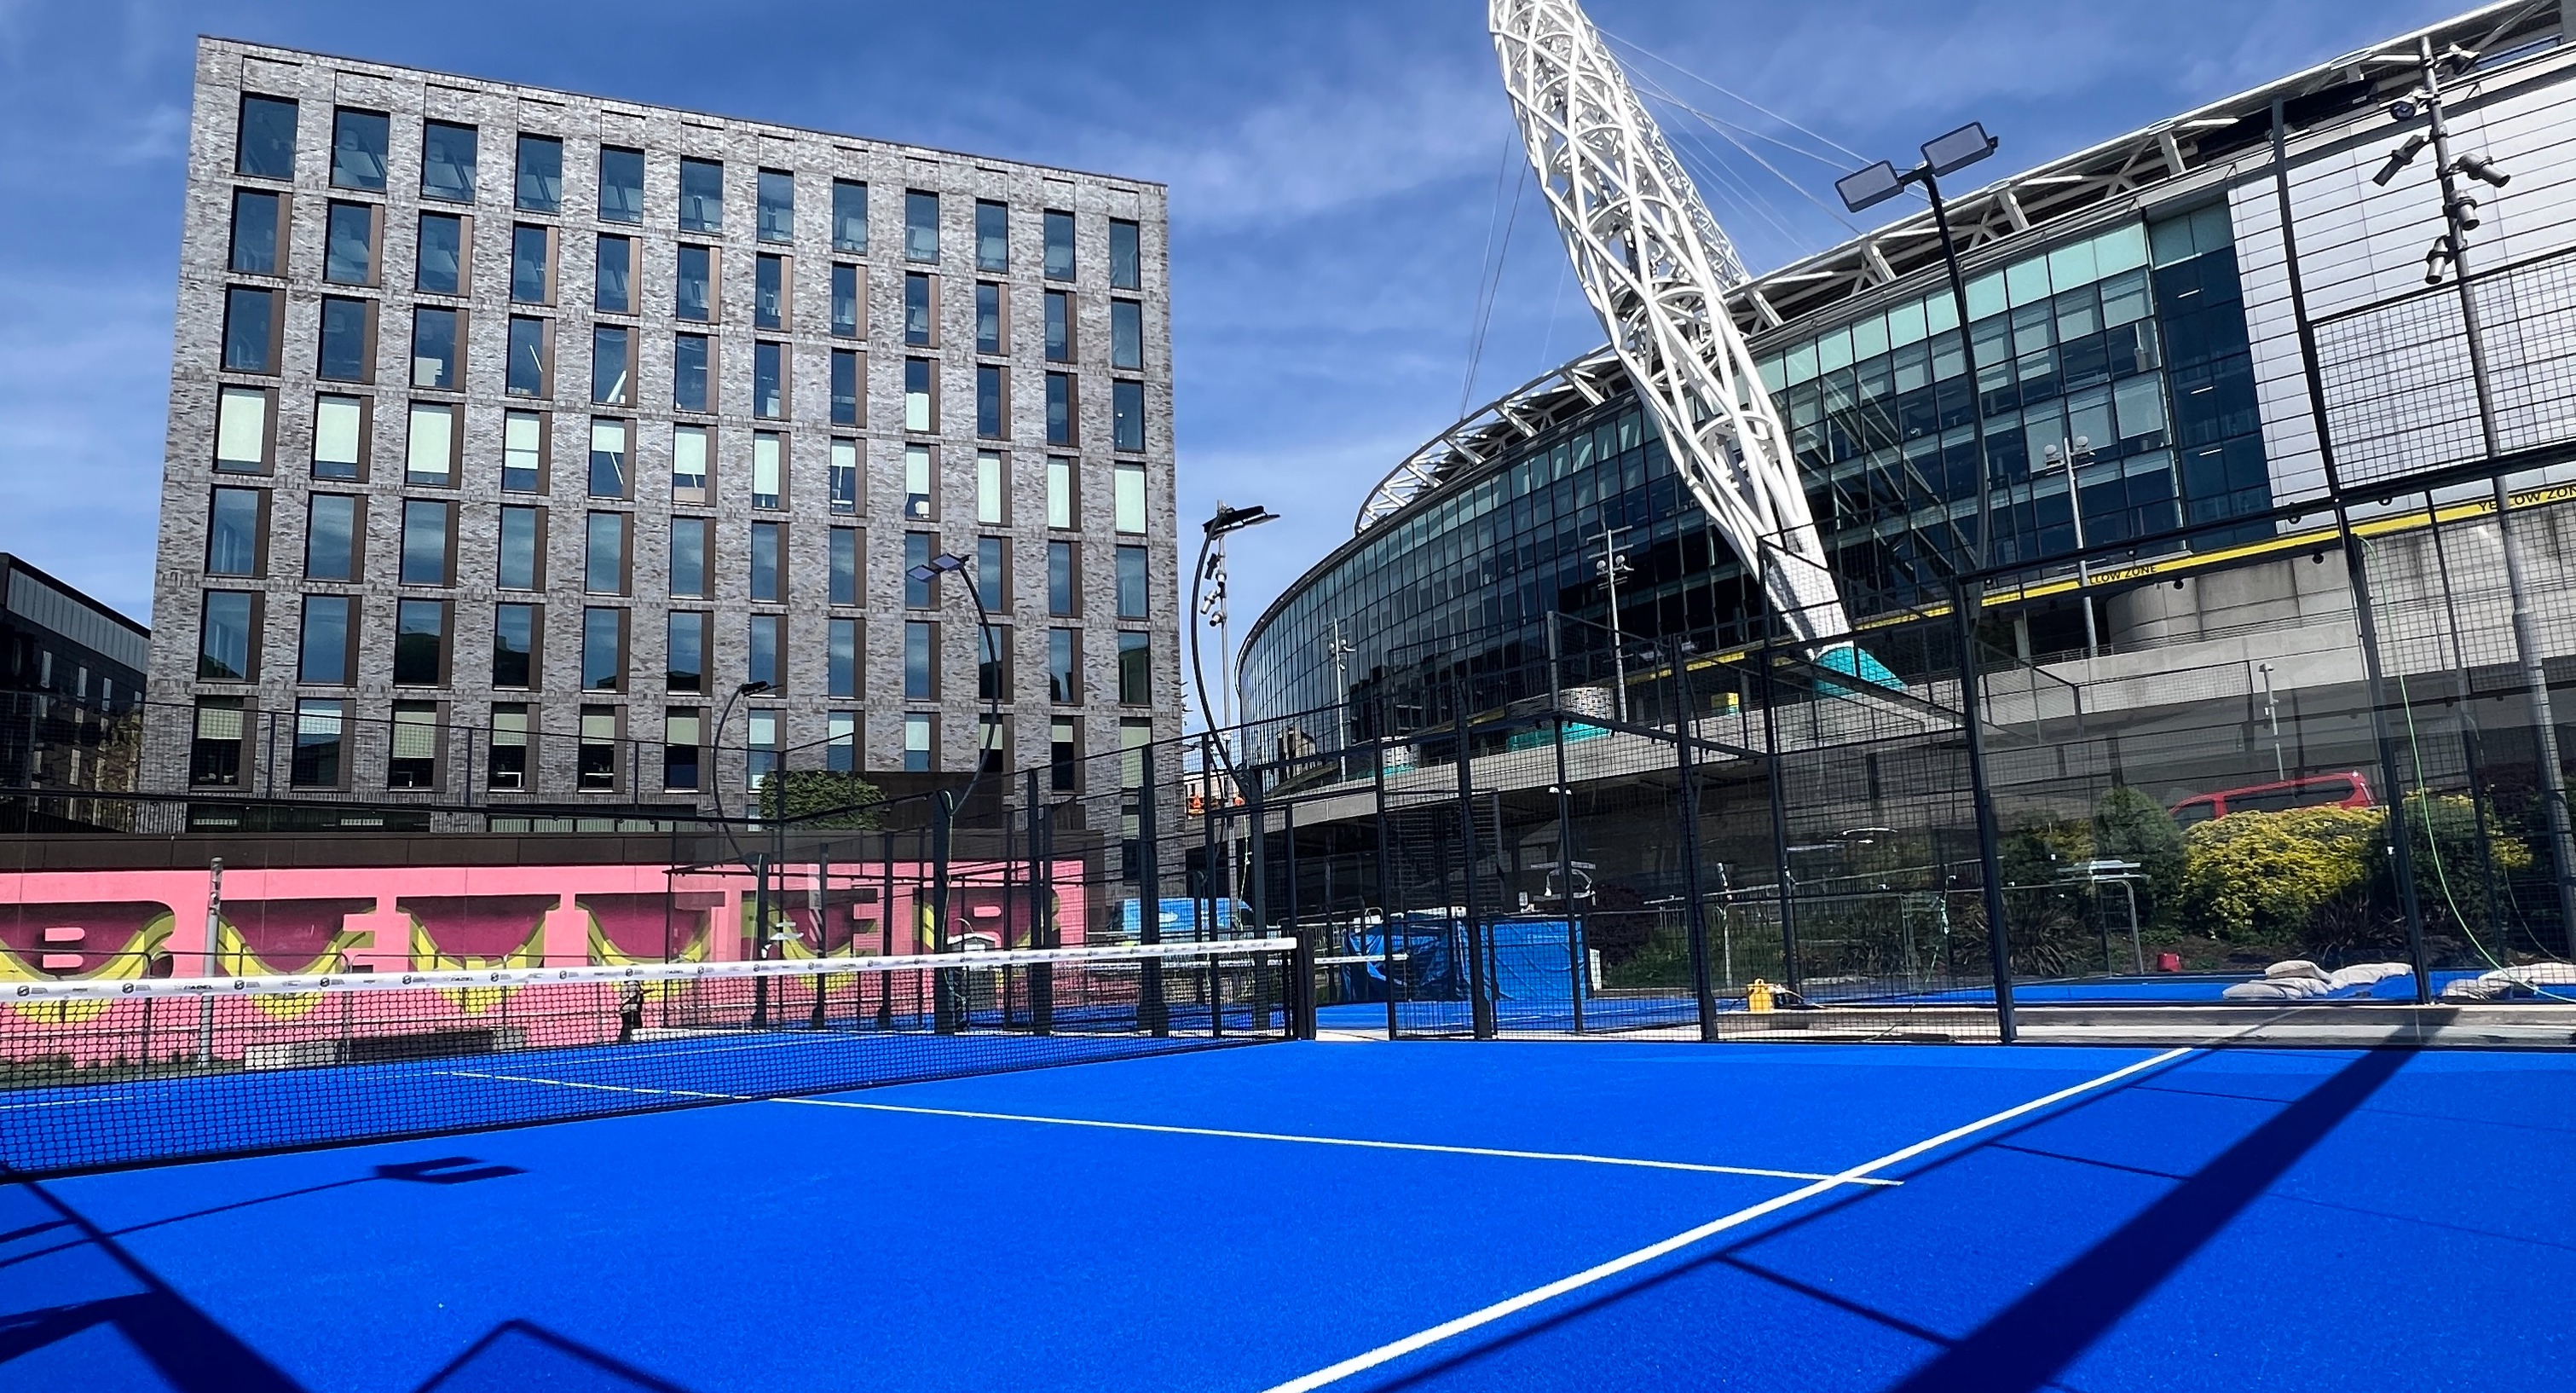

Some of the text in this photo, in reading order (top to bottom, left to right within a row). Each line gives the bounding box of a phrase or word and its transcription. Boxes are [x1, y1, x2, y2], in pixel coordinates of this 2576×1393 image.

[2479, 493, 2541, 512] YEOW
[2086, 565, 2157, 585] LLOW ZONE
